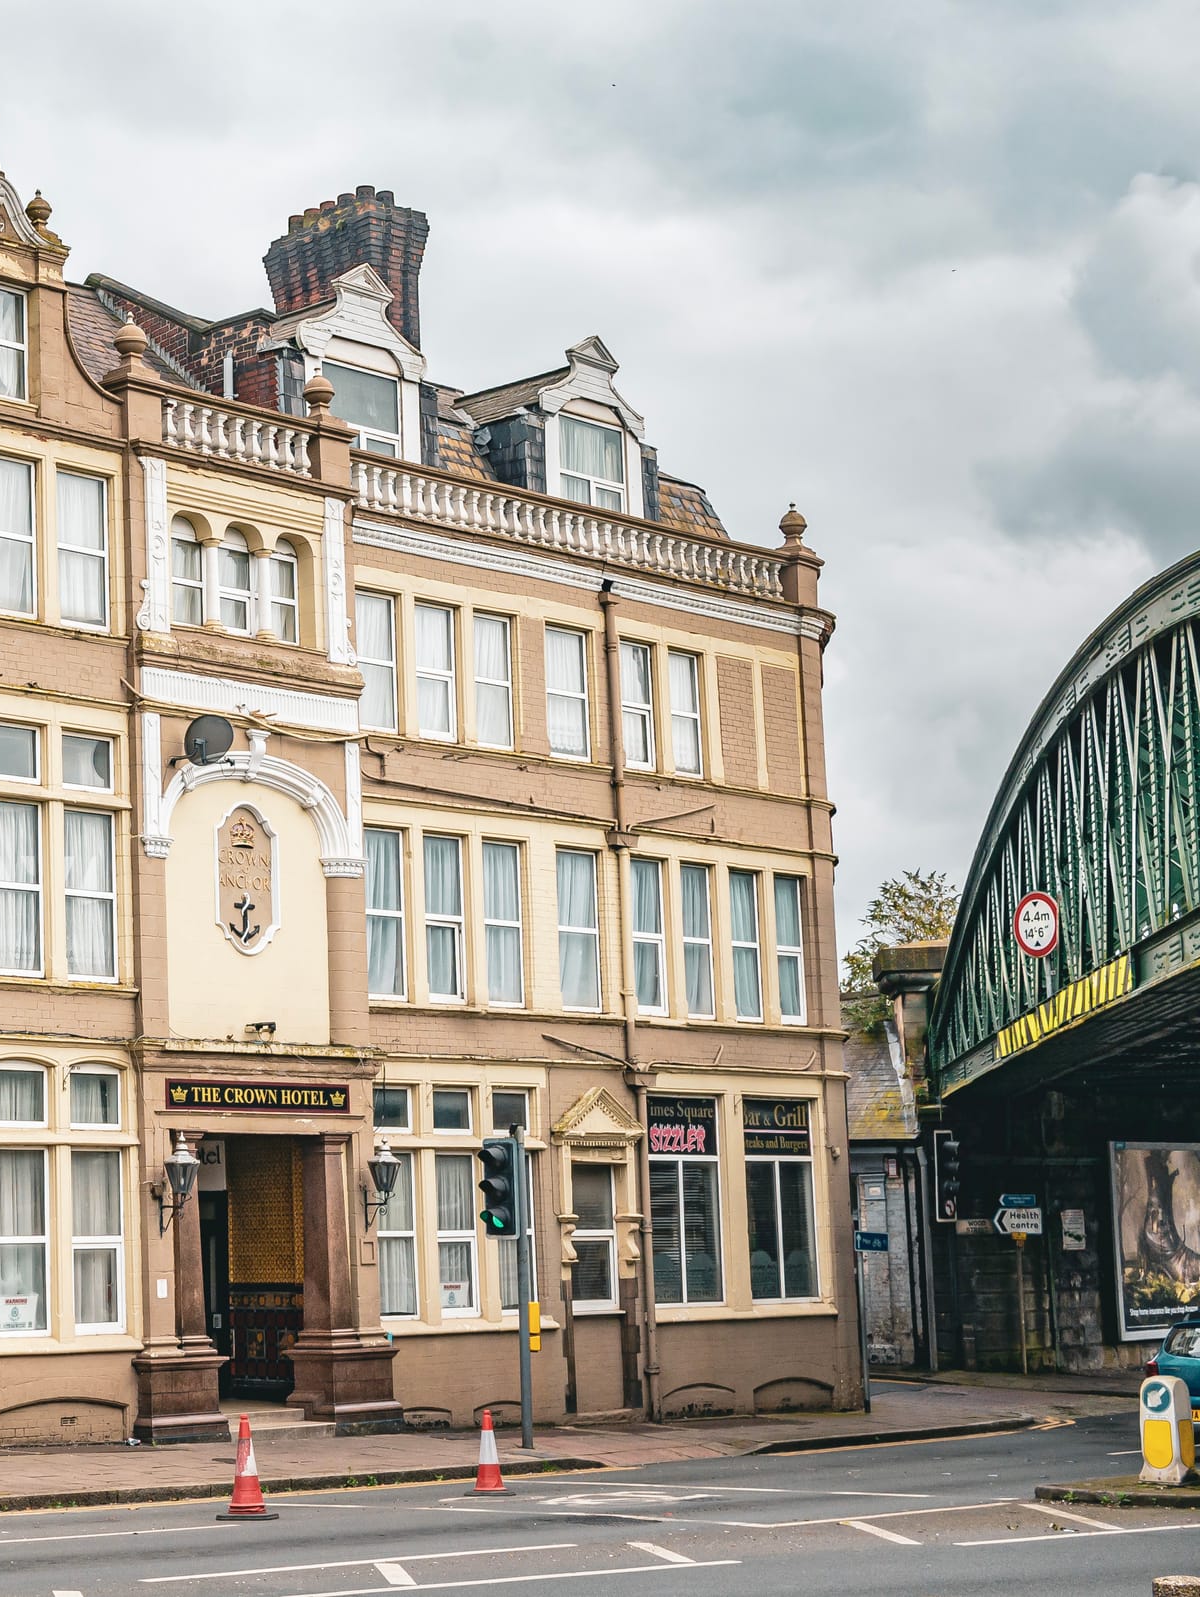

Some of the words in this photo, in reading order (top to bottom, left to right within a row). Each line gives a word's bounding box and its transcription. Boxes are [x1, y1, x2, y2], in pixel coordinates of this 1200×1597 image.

[218, 849, 269, 867] CROWN
[1023, 911, 1050, 923] 4.4m
[191, 1086, 221, 1103] THE
[224, 1088, 278, 1105] CROWN
[281, 1089, 328, 1106] HOTEL
[649, 1101, 675, 1117] imes
[677, 1100, 713, 1123] Square
[763, 1112, 771, 1126] &
[774, 1104, 807, 1127] Grill
[650, 1122, 706, 1153] SIZZLER
[745, 1135, 765, 1149] teaks
[766, 1135, 779, 1149] and
[779, 1135, 808, 1152] Burgers
[1009, 1211, 1039, 1220] Health
